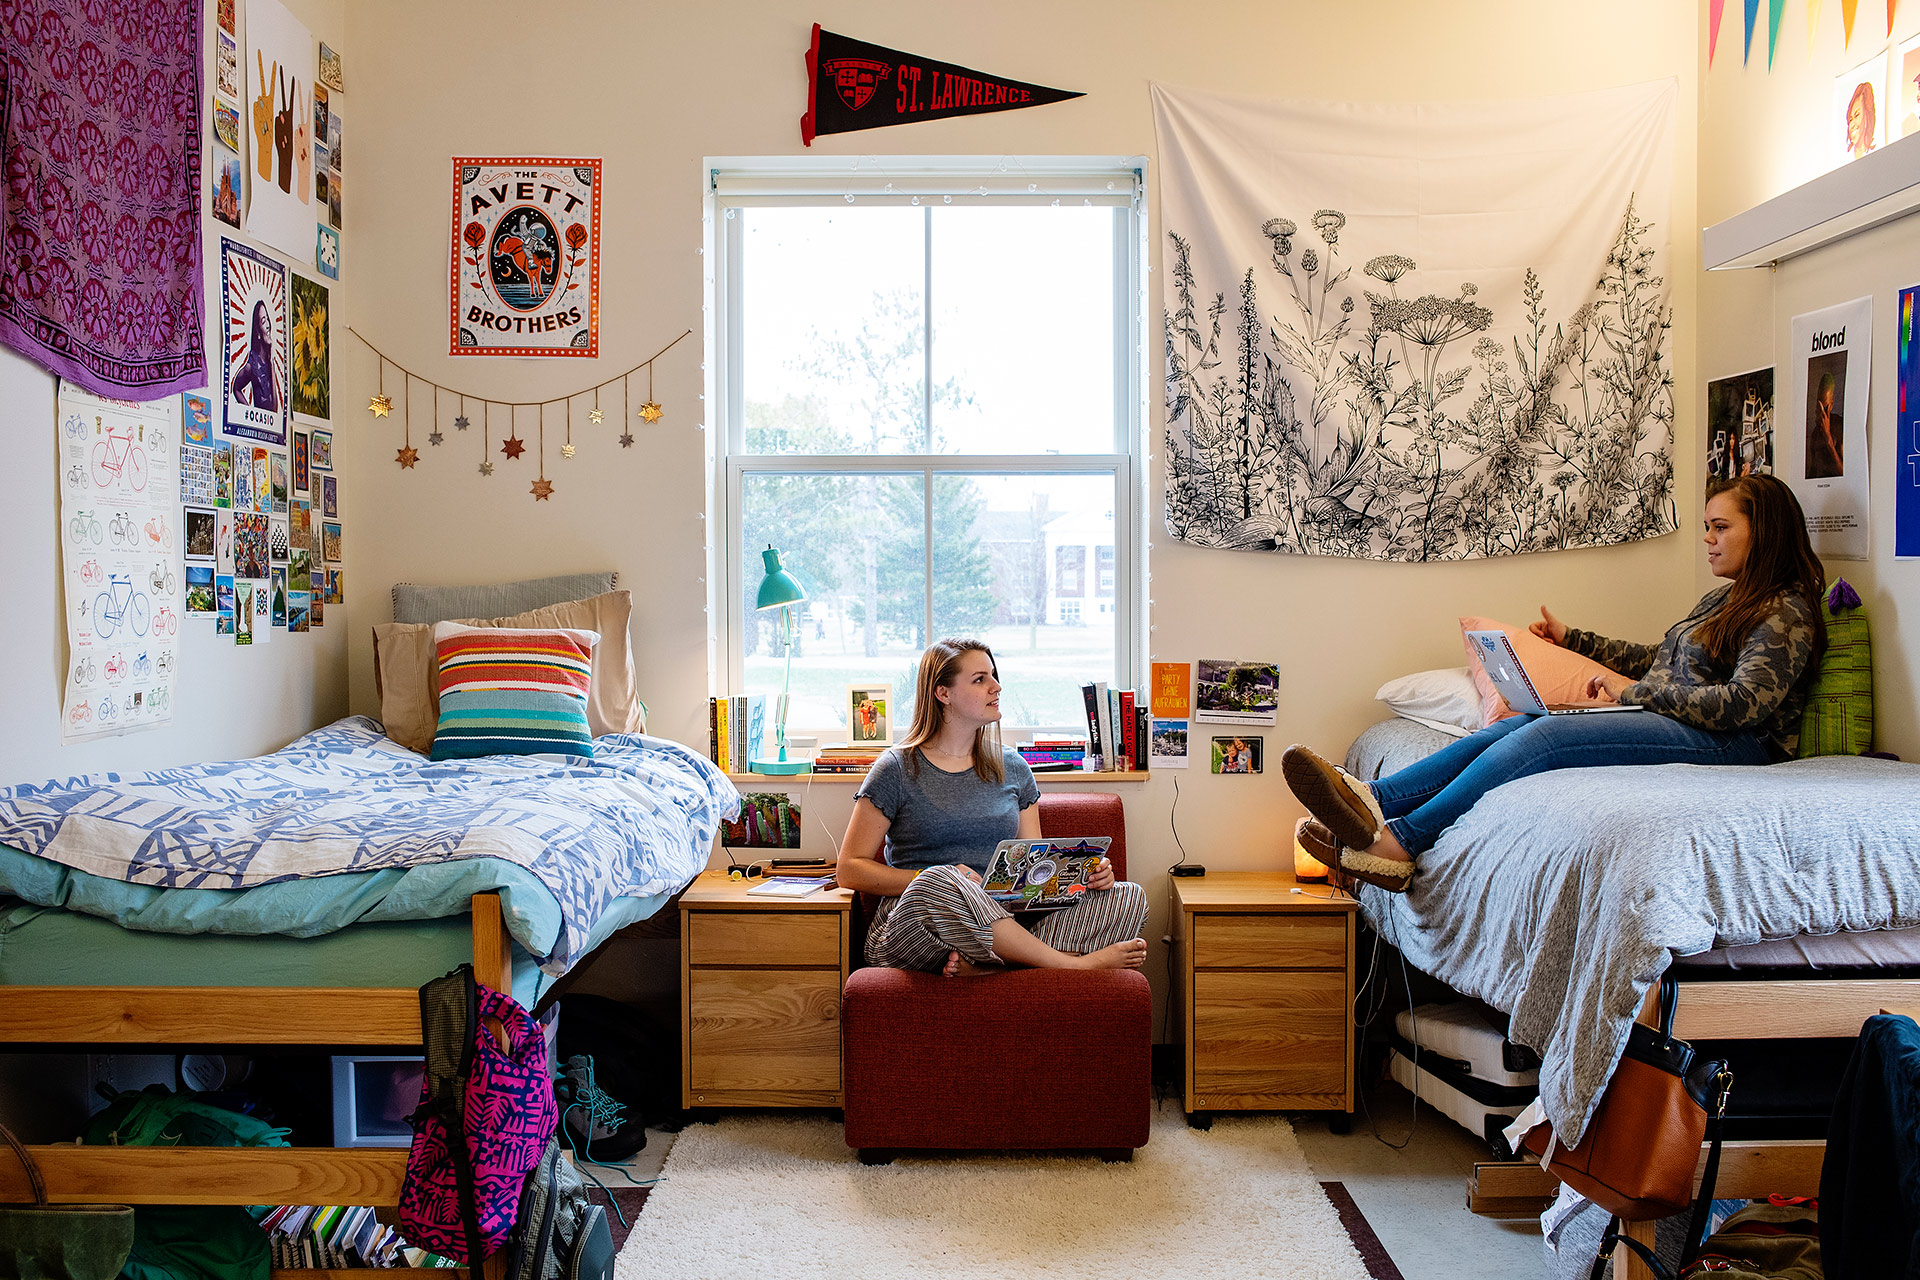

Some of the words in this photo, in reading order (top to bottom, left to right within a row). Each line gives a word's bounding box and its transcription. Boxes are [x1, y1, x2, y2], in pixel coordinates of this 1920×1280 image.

[896, 64, 924, 114] ST.
[930, 71, 1031, 110] LAWRENCE
[470, 182, 585, 216] AVETT
[466, 304, 582, 334] BROTHERS
[1811, 325, 1847, 352] blond
[244, 410, 275, 427] #OCASIO
[1161, 674, 1181, 685] PARTY
